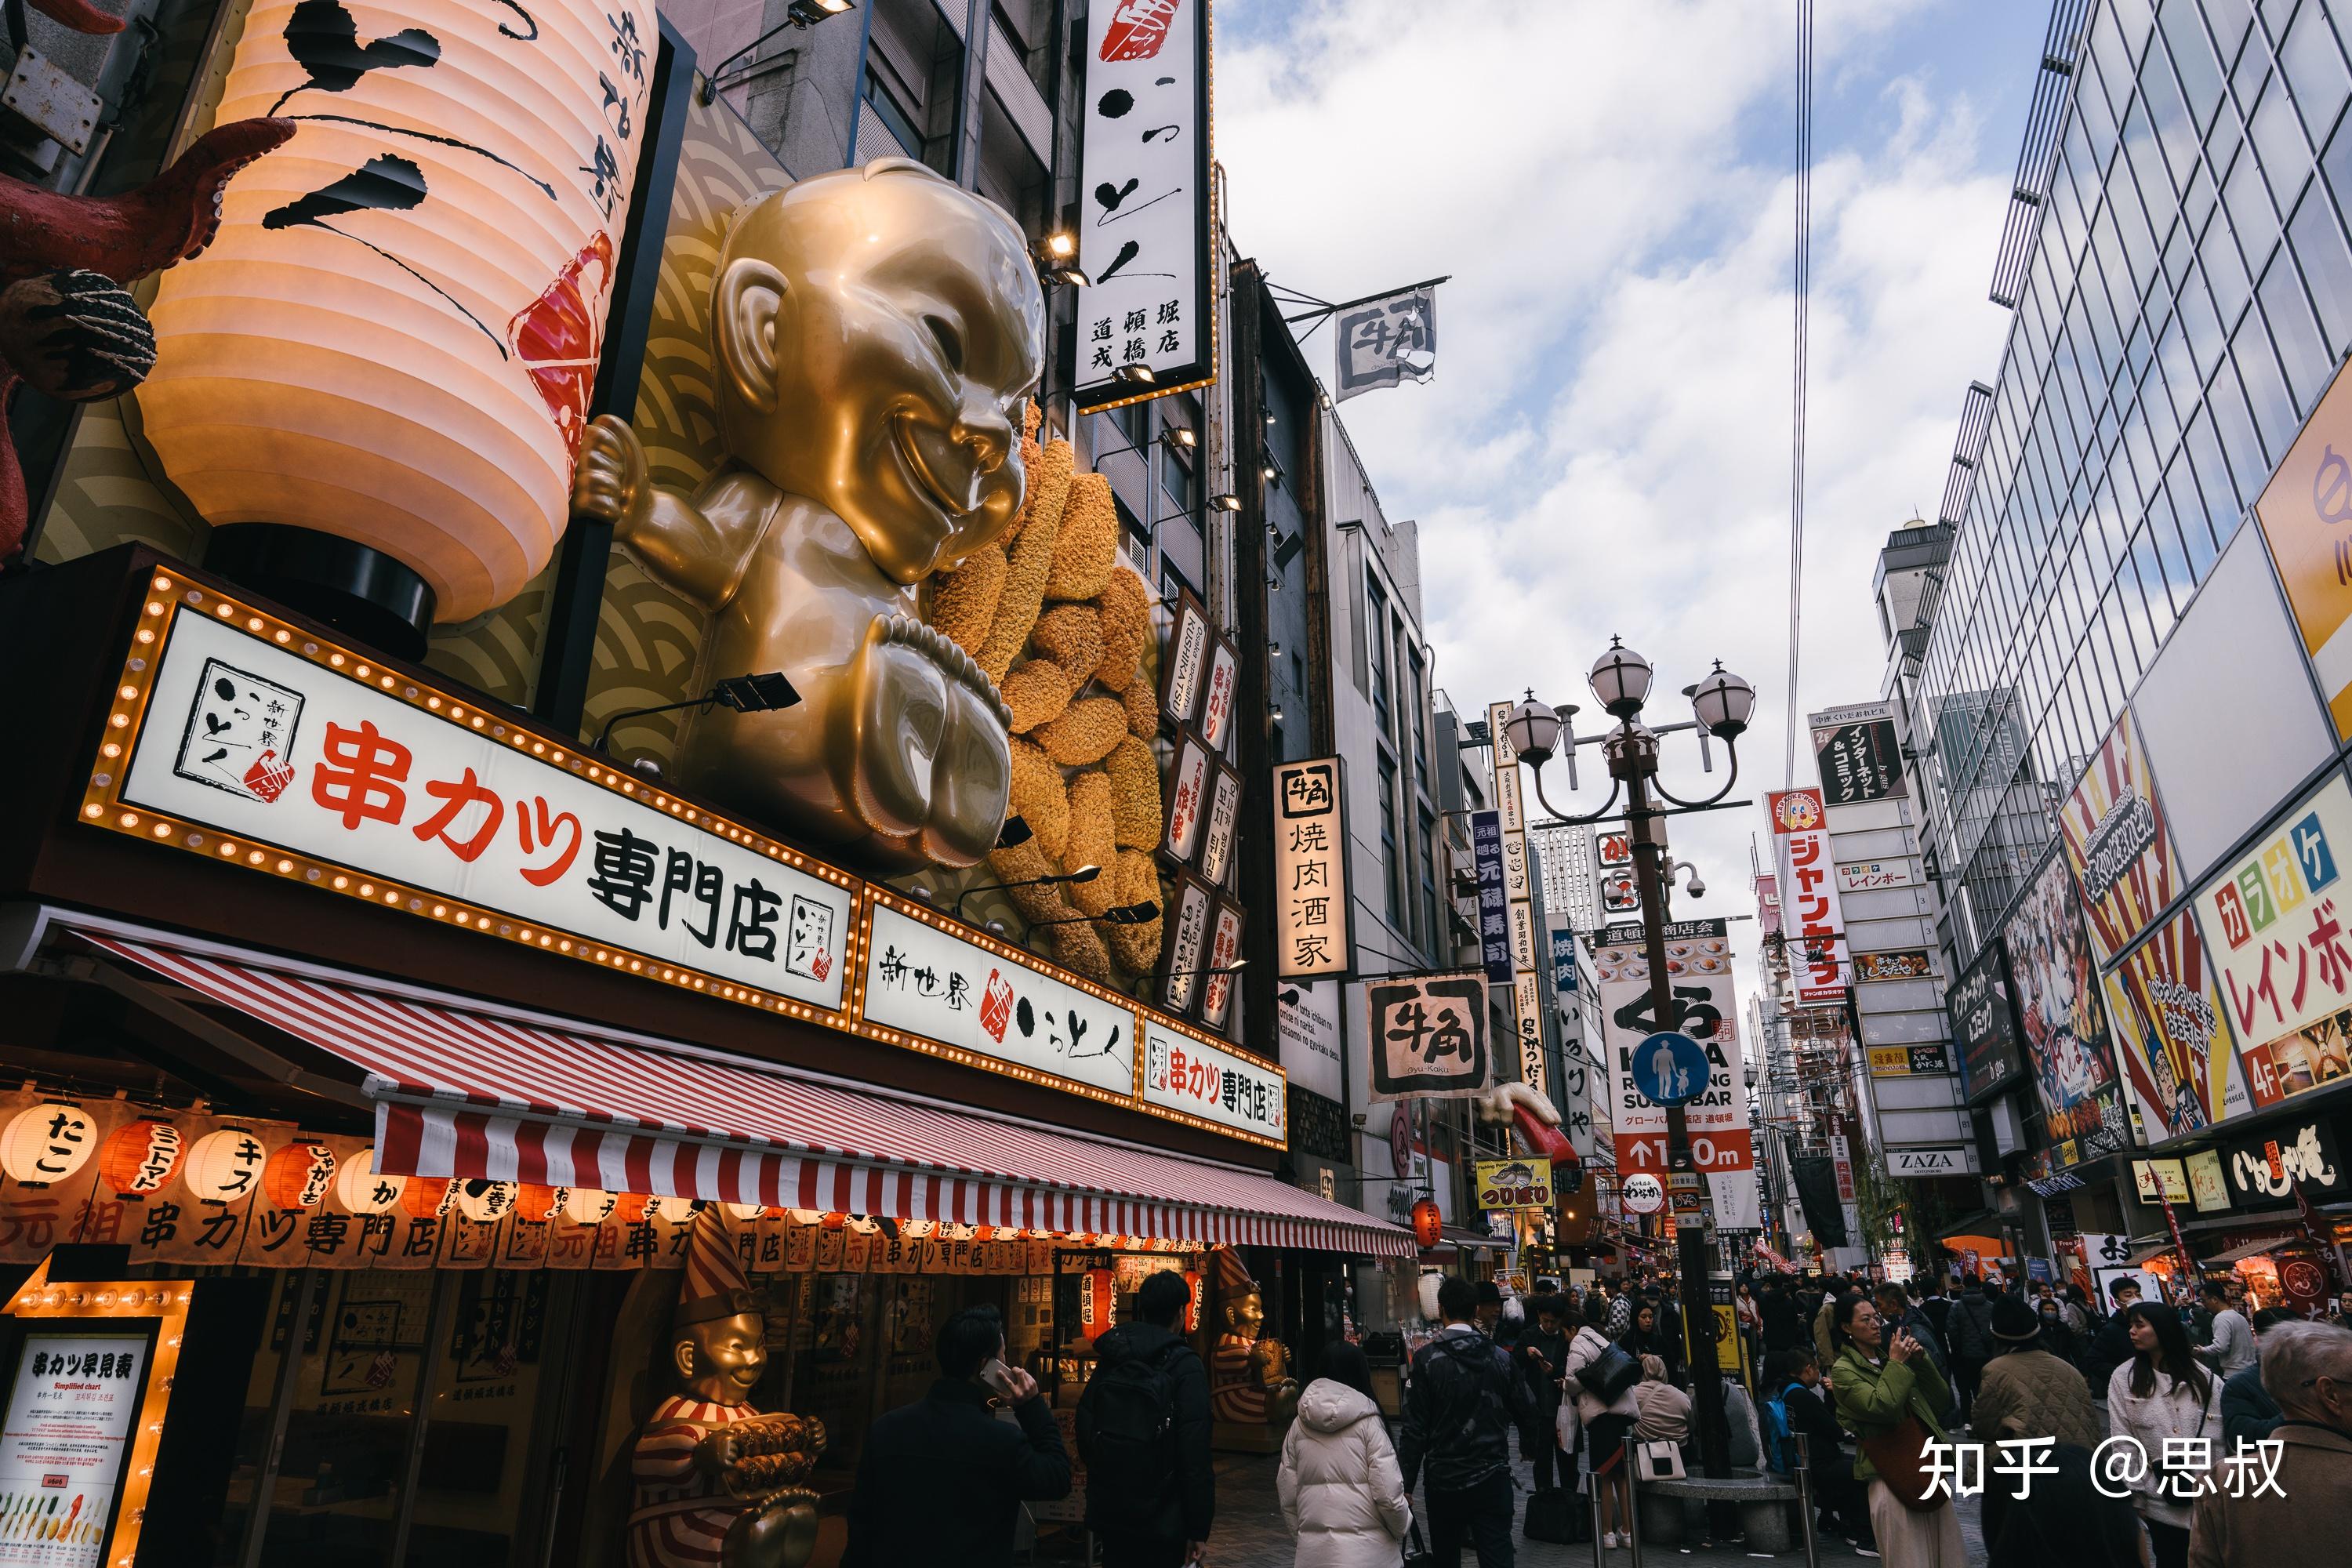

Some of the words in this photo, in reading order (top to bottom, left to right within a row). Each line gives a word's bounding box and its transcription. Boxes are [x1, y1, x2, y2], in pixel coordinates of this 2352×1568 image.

[1185, 661, 1196, 712] specialty
[1207, 664, 1224, 739] 串カツ
[1816, 708, 1886, 724] 中座くいだおれビル
[1816, 731, 1830, 744] 2F
[1834, 741, 1854, 801] &コミック
[1849, 725, 1875, 798] インターネット
[1225, 784, 1235, 827] 오사카
[1289, 778, 1328, 805] 牛角
[314, 720, 783, 964] 串カツ専門店
[1219, 832, 1228, 863] 명물
[1476, 826, 1497, 837] 元祖
[1842, 865, 1880, 875] カラオケ
[1849, 873, 1907, 887] レインボー
[2221, 826, 2325, 943] カラオケ
[1290, 822, 1331, 967] 焼肉酒家
[1479, 860, 1507, 963] 元禄寿司
[1515, 909, 1529, 963] 創業昭和四年
[1553, 939, 1576, 981] 焼肉
[2225, 897, 2352, 1037] レインボ
[1954, 966, 1987, 1020] インターネット
[1294, 1015, 1299, 1026] ni
[1303, 1035, 1308, 1046] no
[1327, 1022, 1333, 1031] no
[1385, 1002, 1474, 1064] 牛角
[1170, 1047, 1266, 1122] 串カツ専門店
[1407, 1065, 1450, 1075] Gyu-Kaku
[1561, 1007, 1590, 1135] いろりや
[2252, 1056, 2275, 1098] 4F
[1690, 1091, 1732, 1106] BAR
[1705, 1113, 1733, 1124] 道頓堀
[36, 1113, 83, 1173] たこ
[132, 1124, 180, 1190] ミニトマト
[1654, 1138, 1739, 1167] 10m
[1900, 1154, 1954, 1168] ZAZA
[219, 1139, 263, 1194] キス
[302, 1145, 337, 1205] じゃがいも
[1481, 1185, 1549, 1206] つりぼり
[1082, 1276, 1093, 1323] 道頓堀
[33, 1352, 133, 1379] 串カツ早見表
[54, 1382, 84, 1391] Simplified
